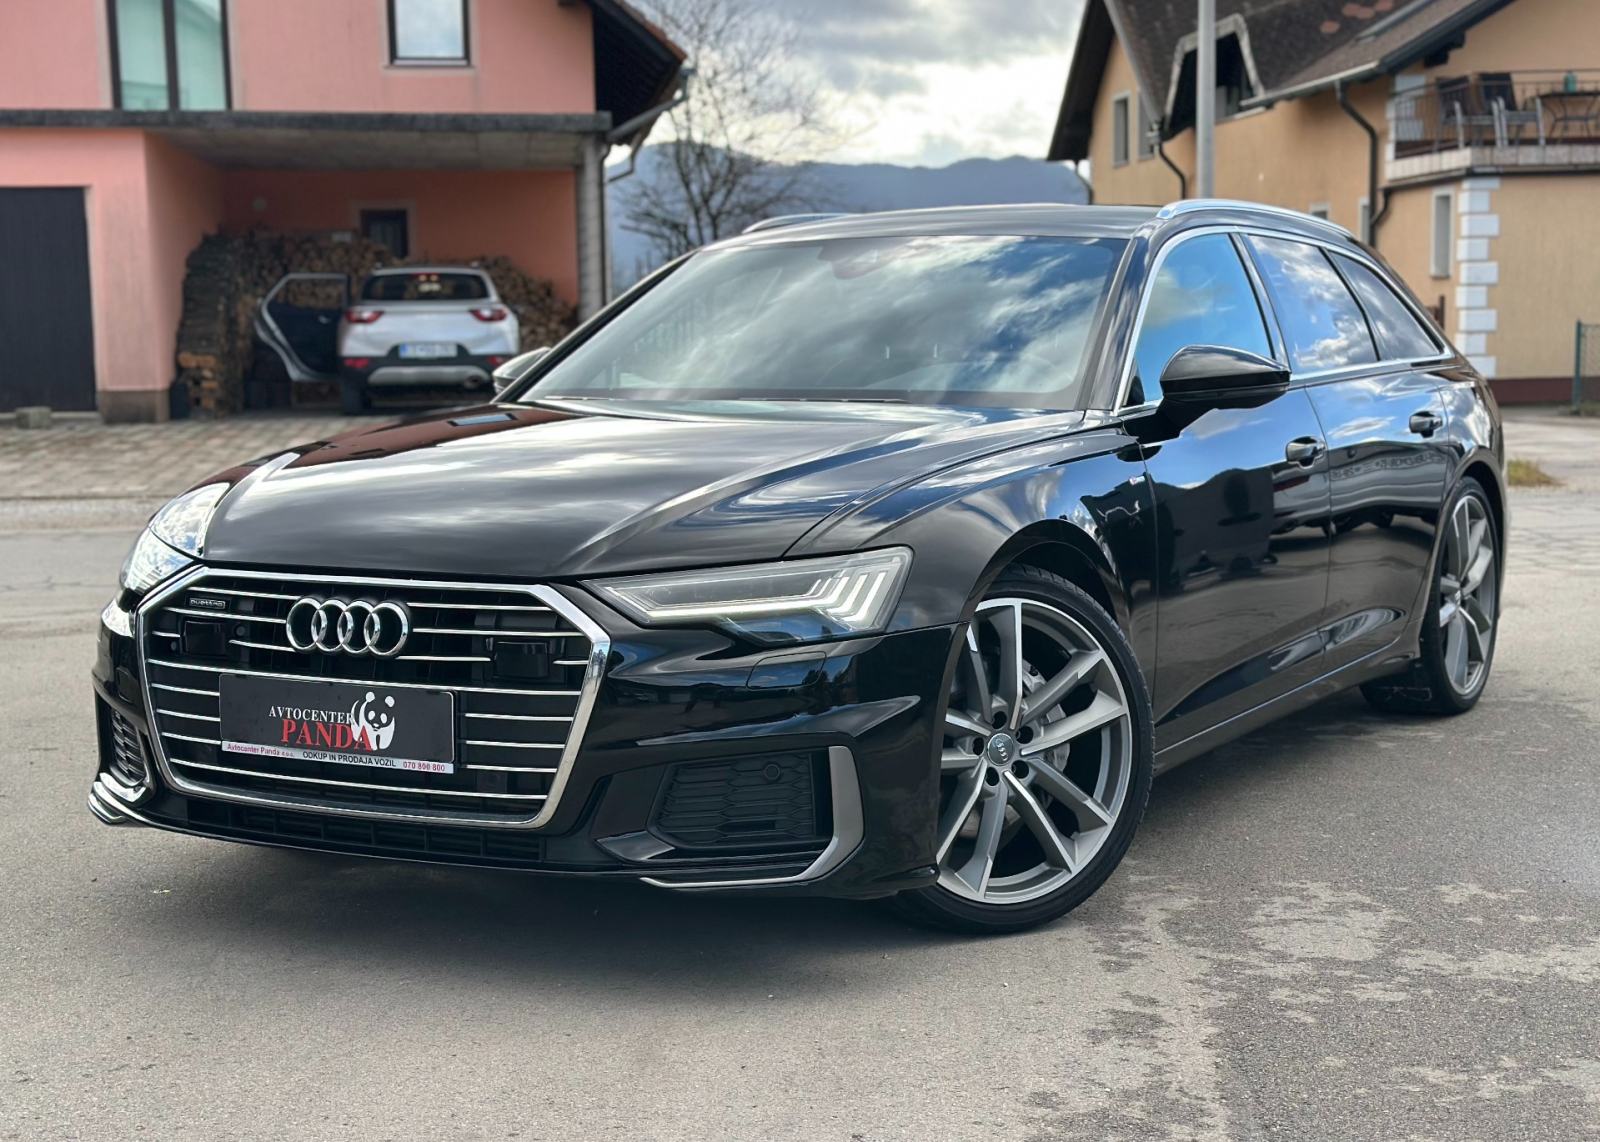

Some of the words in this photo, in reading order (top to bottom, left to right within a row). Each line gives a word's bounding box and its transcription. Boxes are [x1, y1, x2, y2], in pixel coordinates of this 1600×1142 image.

[268, 705, 354, 725] AVTOCENTER
[280, 718, 373, 752] PANDA
[227, 743, 259, 754] Avtocenter
[260, 746, 280, 756] Panda
[303, 751, 327, 760] ODKUP
[337, 754, 374, 765] PRODAJA
[374, 759, 397, 767] VOZIL
[403, 761, 416, 769] 070
[432, 763, 445, 771] 800
